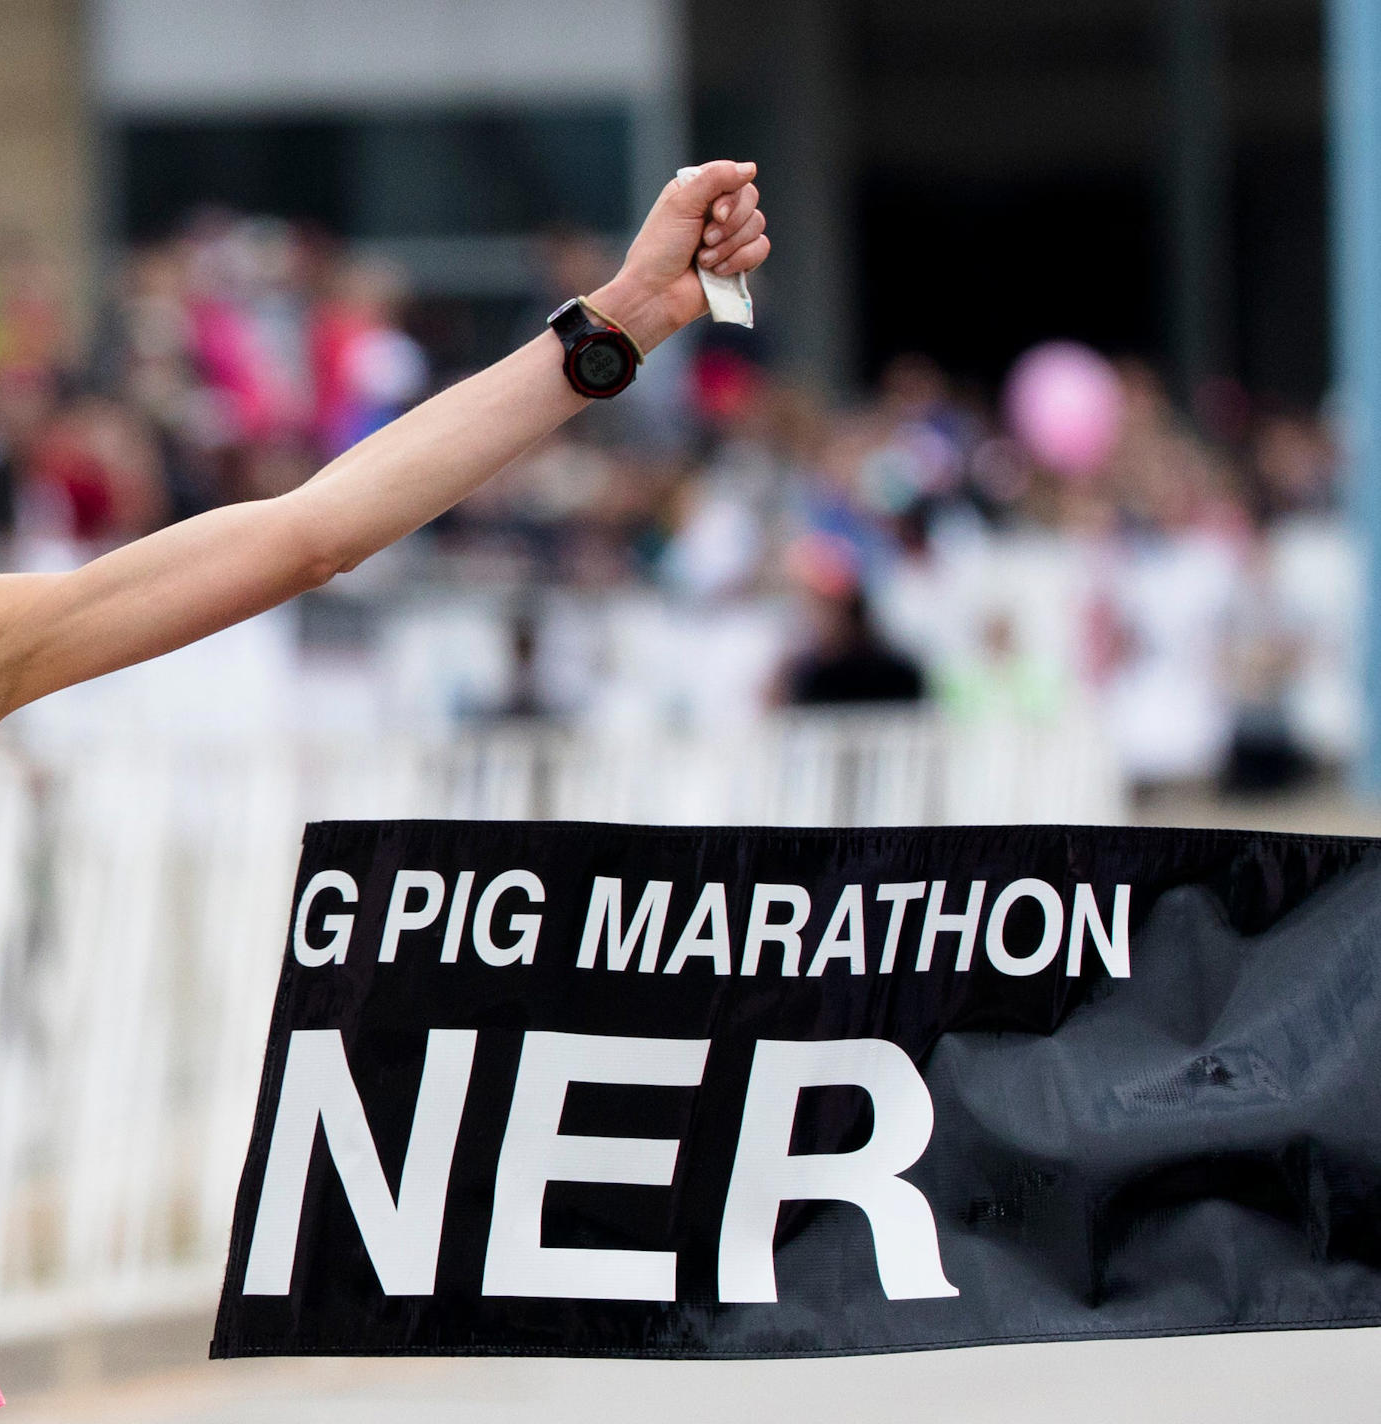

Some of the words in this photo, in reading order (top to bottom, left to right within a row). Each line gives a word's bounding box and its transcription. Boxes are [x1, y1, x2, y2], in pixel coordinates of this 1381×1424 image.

[293, 870, 359, 968] G
[377, 870, 546, 967] PIG
[576, 877, 1132, 979] MARATHON
[242, 1028, 960, 1305] NER
